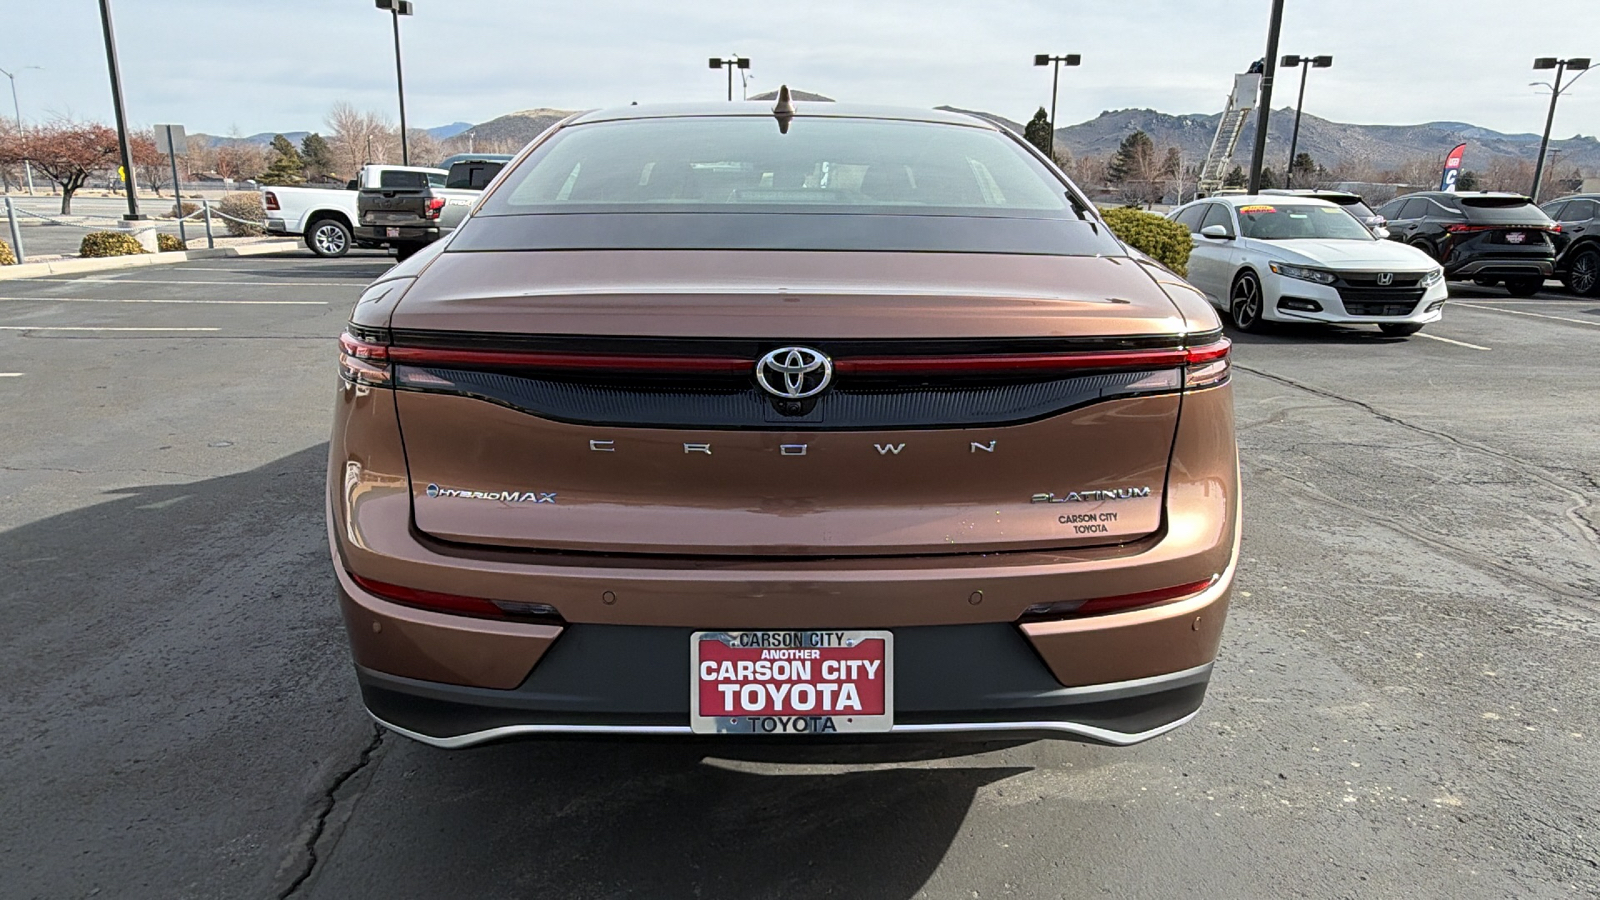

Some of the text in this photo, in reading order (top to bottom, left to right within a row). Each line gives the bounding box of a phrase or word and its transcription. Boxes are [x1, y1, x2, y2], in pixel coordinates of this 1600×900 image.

[589, 439, 996, 456] CROWN
[1031, 486, 1151, 504] PLATINUM
[1058, 512, 1118, 524] CARSON CITY
[1073, 524, 1108, 534] TOYOTA
[739, 632, 845, 648] CARSON CITY
[761, 649, 820, 660] ANOTHER
[700, 659, 881, 681] CARSON CITY
[718, 683, 862, 711] TOYOTA
[748, 716, 837, 732] TOYOTA
